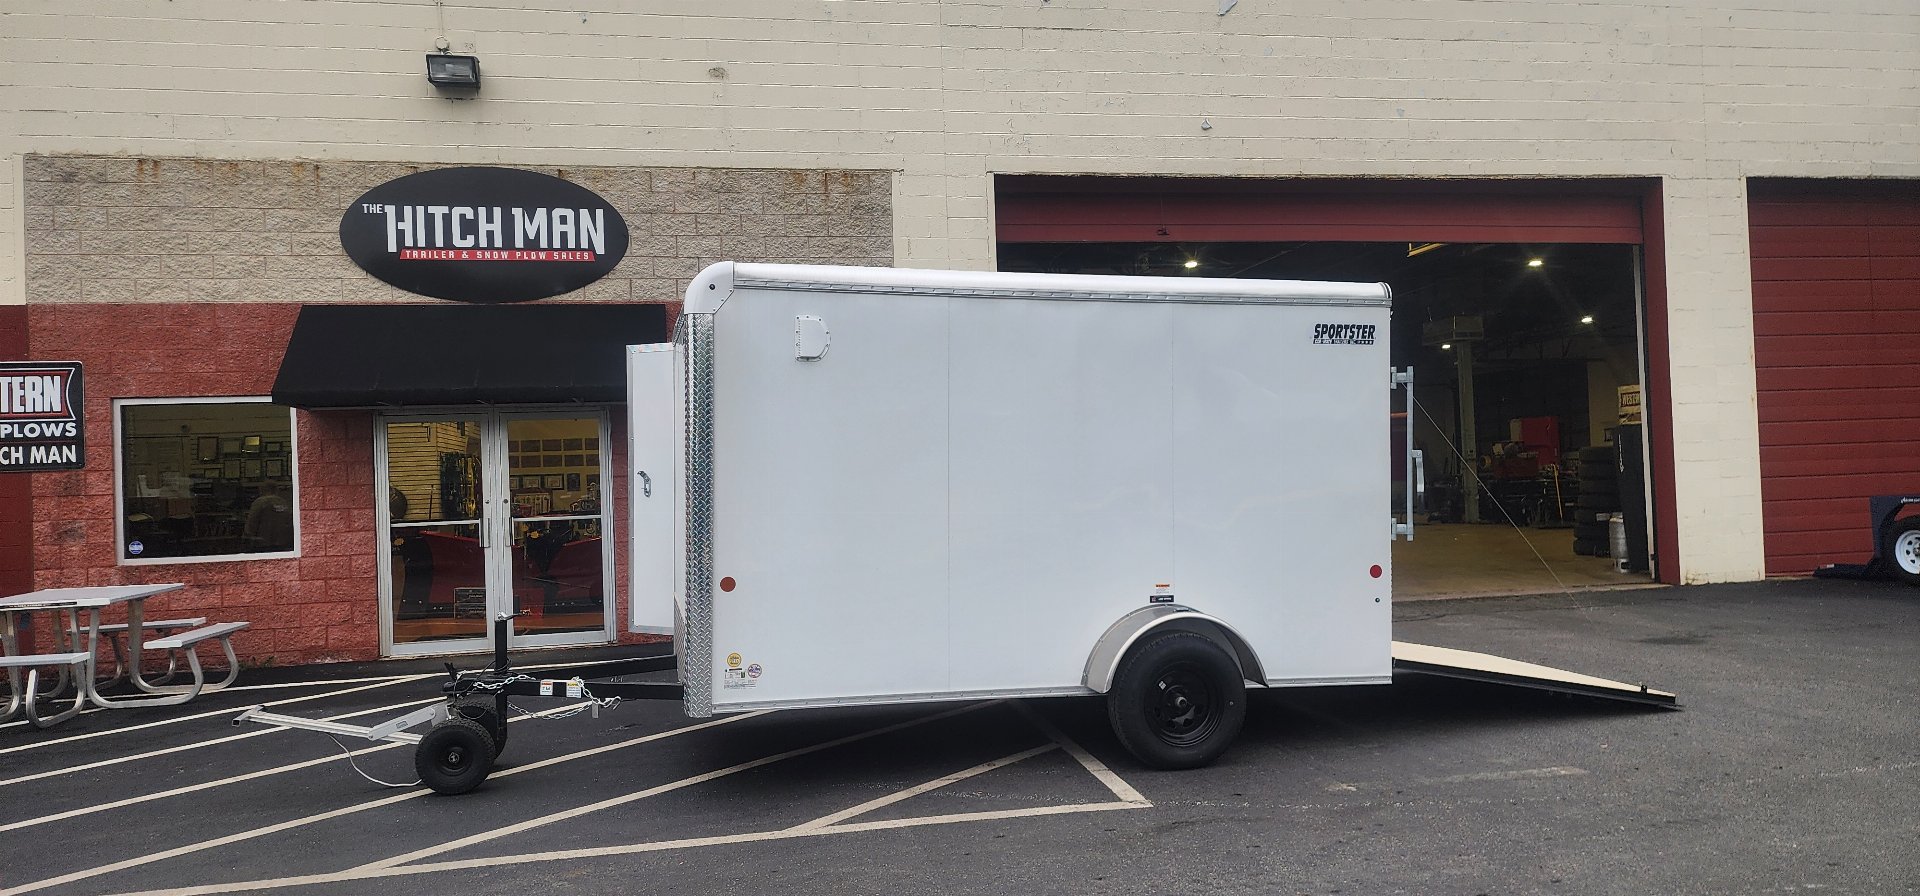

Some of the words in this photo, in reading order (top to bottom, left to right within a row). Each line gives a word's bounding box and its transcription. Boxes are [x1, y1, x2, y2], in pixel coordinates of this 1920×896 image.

[362, 203, 383, 214] THE
[384, 204, 503, 253] HITCH
[511, 207, 606, 255] MAN
[405, 250, 455, 259] TRAILER
[461, 250, 469, 258] &
[476, 251, 509, 259] SNOW
[516, 251, 547, 260] PLOW
[553, 251, 590, 261] SALES
[1314, 323, 1376, 339] SPORTSTER
[0, 376, 61, 412] TERN
[0, 422, 76, 438] PLOWS
[30, 445, 76, 464] MAN
